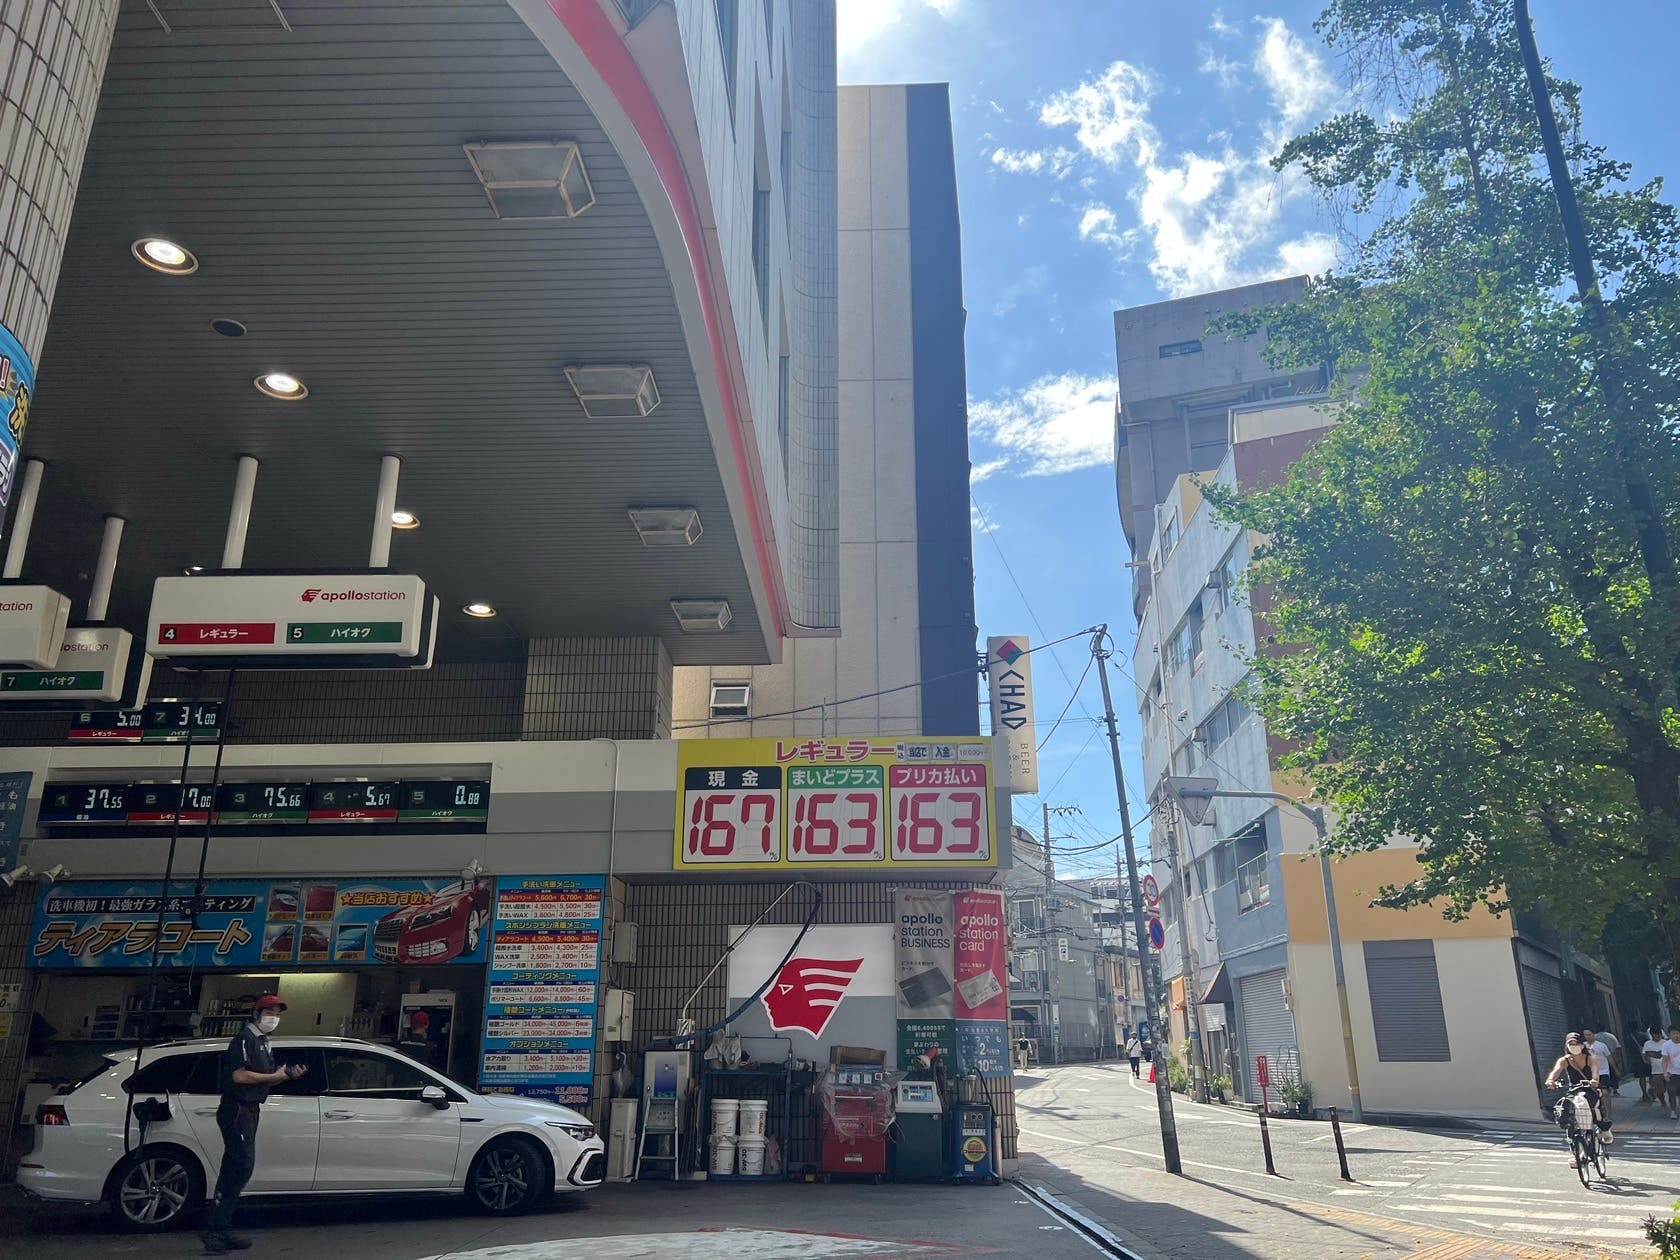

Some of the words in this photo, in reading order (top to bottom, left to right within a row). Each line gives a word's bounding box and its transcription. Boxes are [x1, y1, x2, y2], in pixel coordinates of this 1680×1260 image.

[321, 589, 406, 602] apollostation
[165, 629, 175, 638] 4
[200, 629, 248, 639] レギュラー
[293, 628, 302, 638] 5
[331, 628, 371, 638] ハイオク
[7, 677, 15, 686] 7
[40, 676, 76, 685] ハイオク
[80, 713, 91, 723] 6
[775, 741, 896, 763] レギュラー
[909, 747, 927, 757] 当店で
[936, 747, 950, 757] 入金
[1021, 743, 1030, 774] BEER
[708, 771, 759, 787] 現金
[792, 769, 880, 786] まいどプラス
[900, 769, 977, 785] プリカ払い
[145, 795, 156, 803] 2
[234, 794, 245, 802] 3
[323, 792, 334, 801] 4
[414, 792, 424, 800] 5
[688, 795, 776, 855] 167
[793, 793, 878, 855] 163
[897, 792, 981, 854] 163
[353, 893, 422, 905] 当店おすすめ
[901, 914, 943, 925] apollo
[961, 914, 999, 928] apollo
[35, 920, 251, 955] ティアラコート
[901, 926, 943, 937] station
[960, 928, 999, 940] station
[901, 938, 951, 949] BUSINESS
[960, 940, 985, 952] card
[979, 1043, 986, 1055] 2
[978, 1059, 989, 1072] 10
